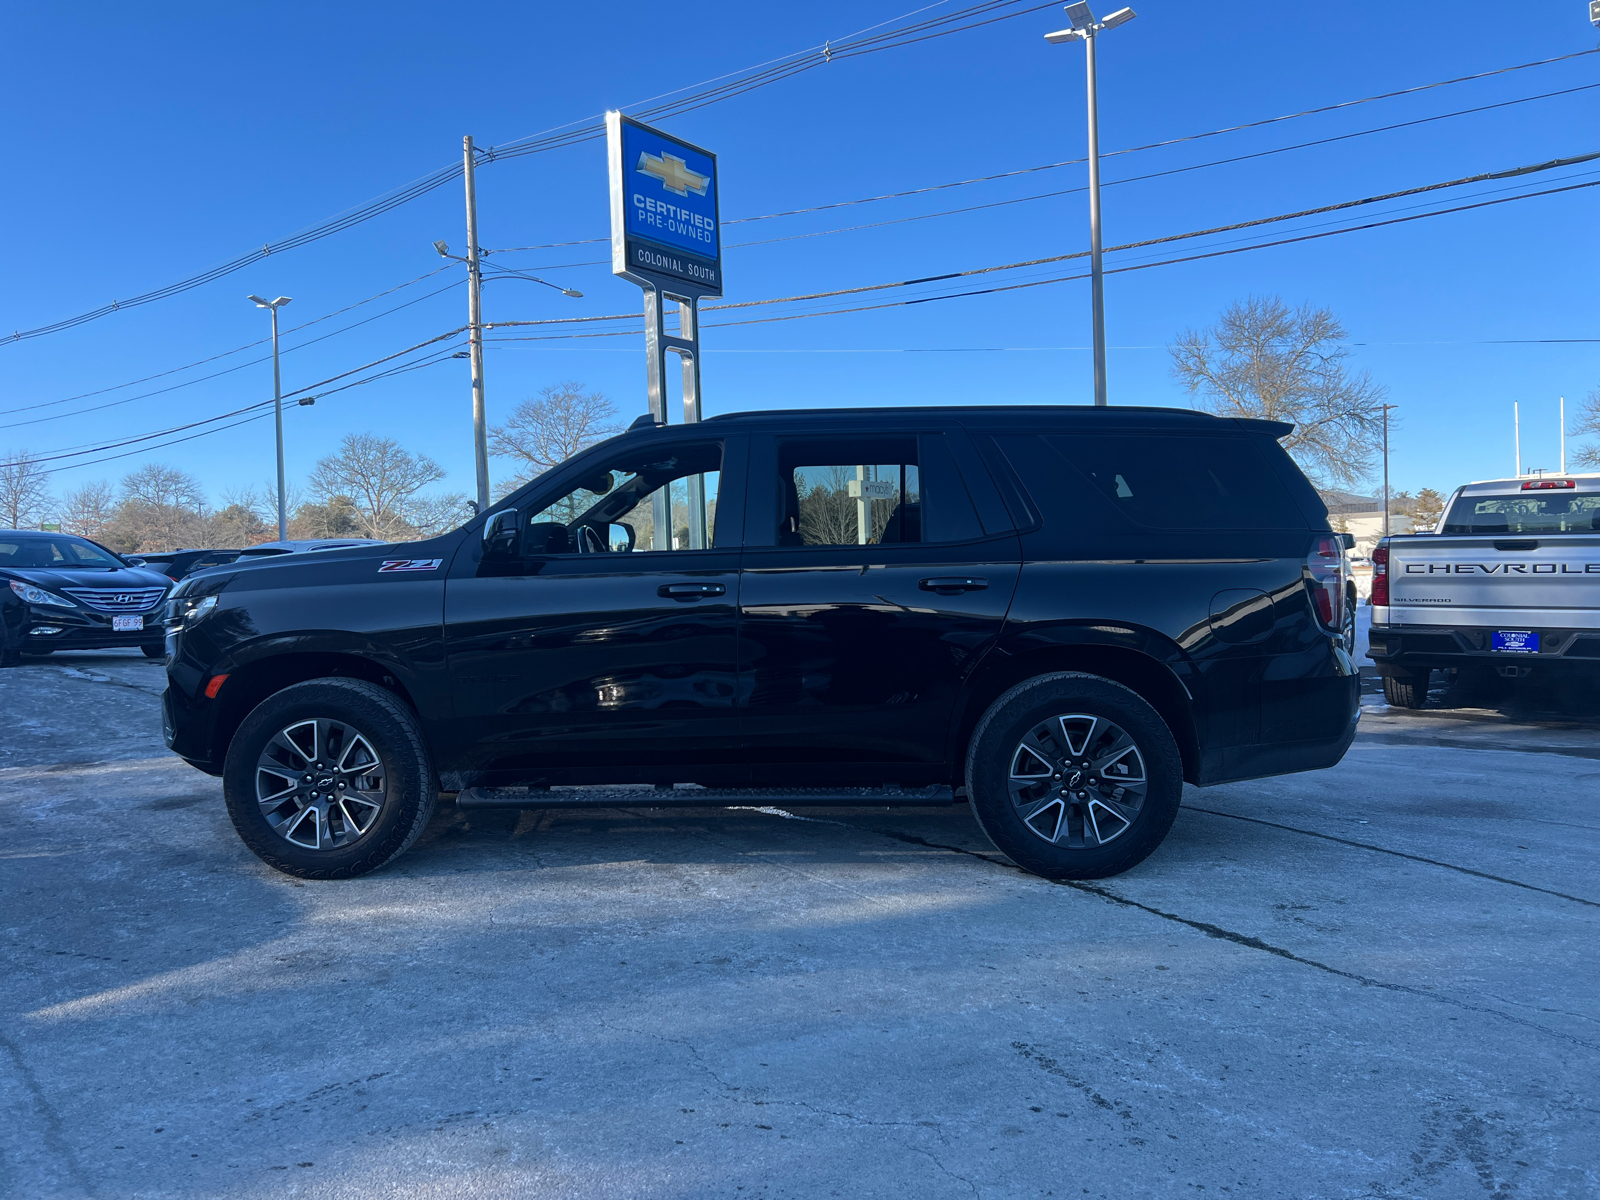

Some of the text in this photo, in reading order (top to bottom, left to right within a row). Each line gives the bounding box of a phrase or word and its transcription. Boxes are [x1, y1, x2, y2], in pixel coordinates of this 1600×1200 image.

[633, 193, 714, 231] CERTIFIED
[638, 209, 712, 243] PRE-OWNED
[637, 249, 715, 281] COLONIAL SOUTH
[377, 558, 443, 573] Z71
